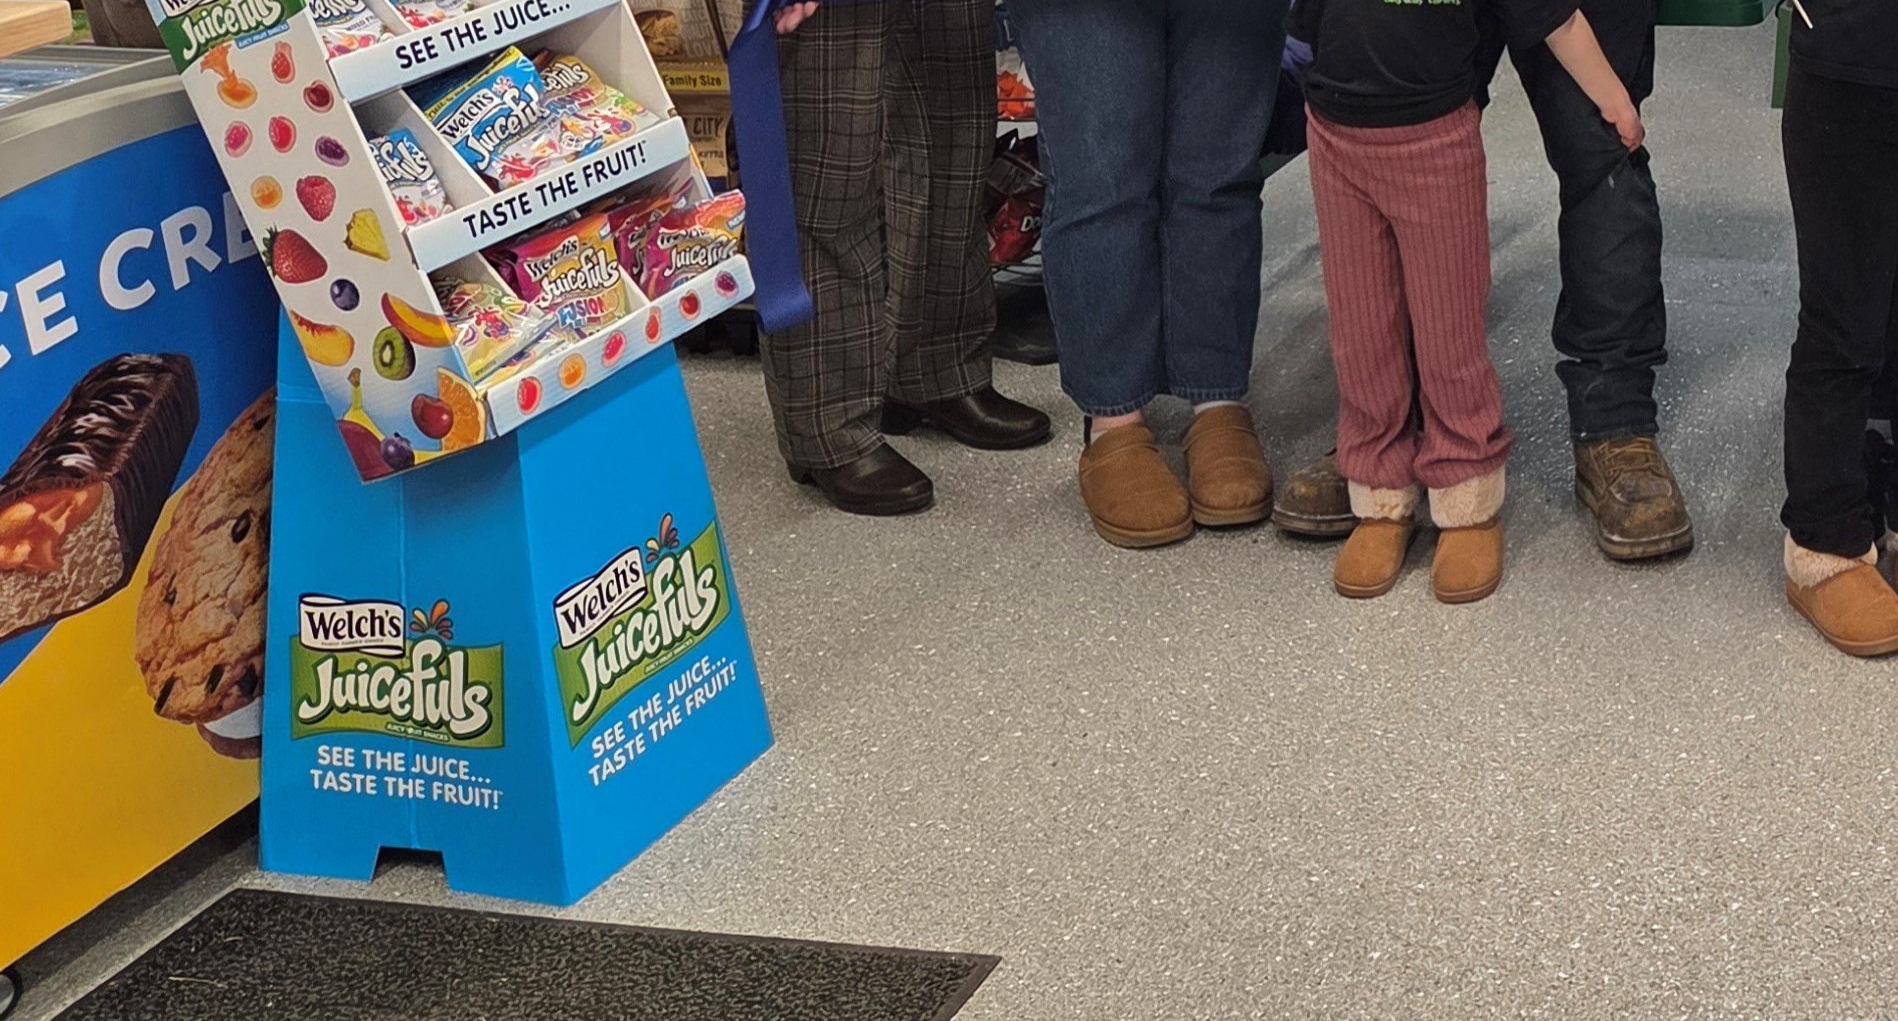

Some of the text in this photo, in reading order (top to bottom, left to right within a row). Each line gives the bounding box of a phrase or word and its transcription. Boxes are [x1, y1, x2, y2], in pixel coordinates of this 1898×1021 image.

[396, 35, 439, 69] SEE
[440, 18, 487, 52] THE
[662, 74, 722, 88] Family Size
[442, 91, 495, 141] Welch's
[462, 142, 646, 238] TASTE THE FRUIT!
[538, 248, 621, 304] Juicefuls
[304, 608, 401, 641] Welch's
[560, 559, 641, 635] Welch's
[572, 549, 718, 722] Juicefuls
[298, 639, 490, 734] Juicefuls
[591, 720, 626, 759] SEE
[627, 692, 663, 731] THE
[666, 655, 728, 705] JUICE...
[587, 663, 736, 787] TASTE THE FRUIT!
[309, 768, 500, 811] TASTE THE FRUIT!
[317, 744, 492, 784] SEE THE JUICE...
